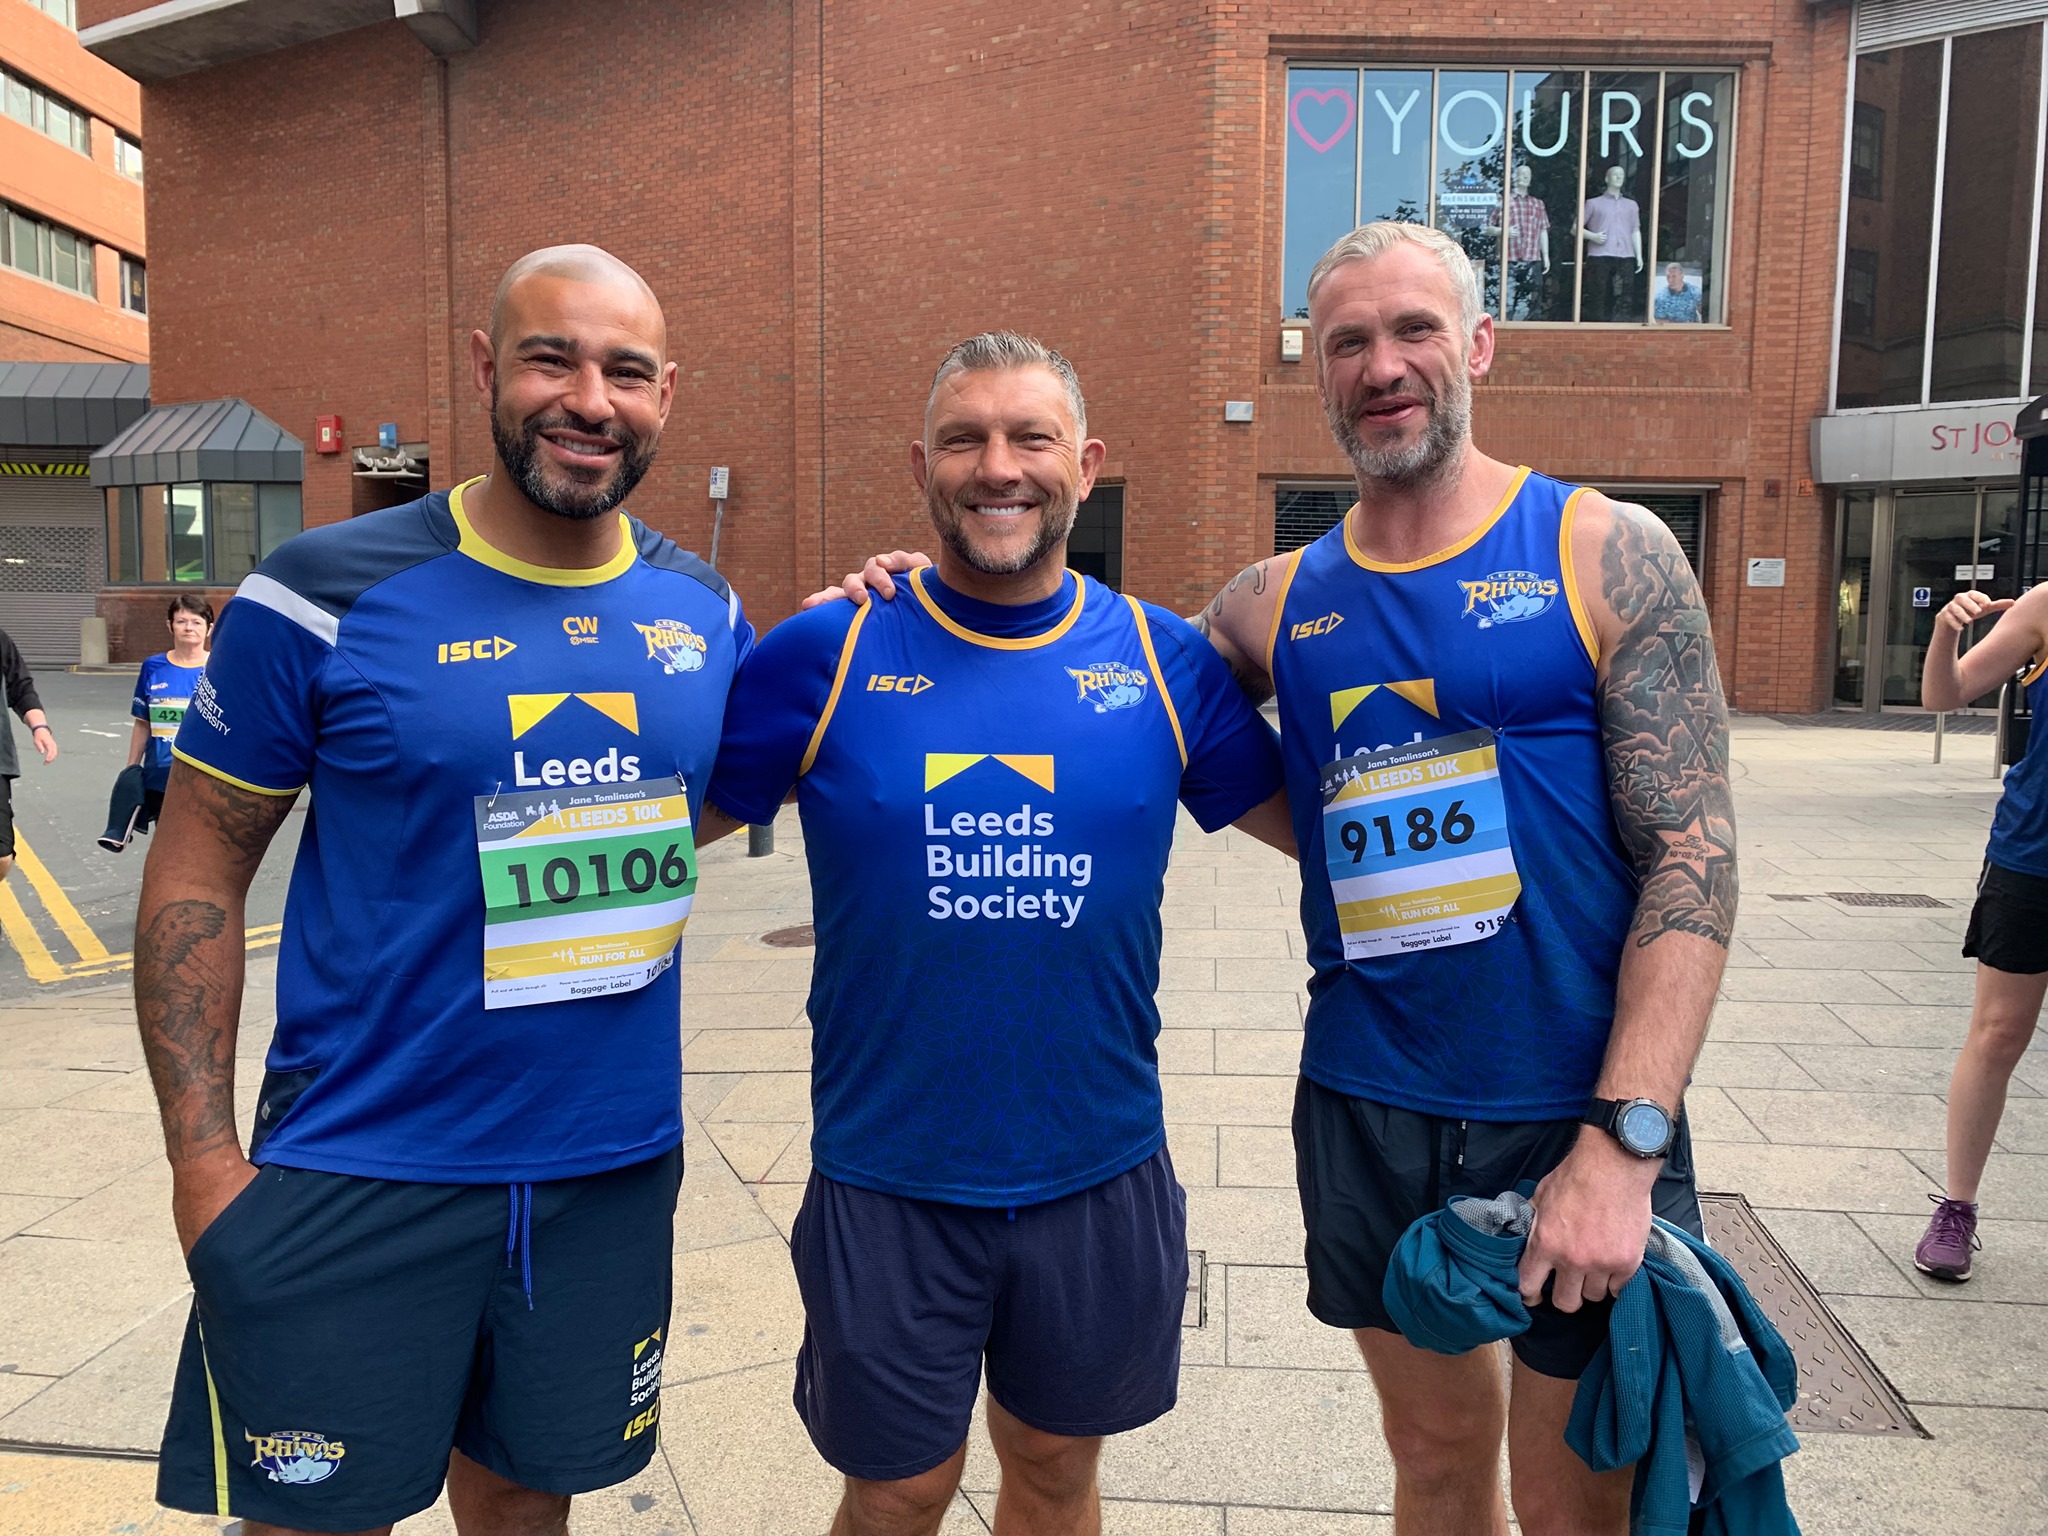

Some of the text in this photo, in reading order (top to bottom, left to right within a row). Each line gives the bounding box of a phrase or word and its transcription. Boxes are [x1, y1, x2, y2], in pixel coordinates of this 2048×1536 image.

[1375, 89, 1714, 159] YOURS
[1931, 421, 2021, 454] ST JO
[563, 616, 599, 635] CW
[1290, 616, 1329, 641] ISC
[438, 639, 492, 664] ISC
[866, 673, 914, 693] ISC
[513, 747, 641, 787] Leeds
[1367, 747, 1440, 770] Jane Tomlinson's
[1370, 758, 1461, 791] LEEDS 10K
[568, 790, 646, 806] Jane Tomlinson's
[483, 819, 525, 831] Foundation
[488, 810, 519, 824] ASDA
[569, 803, 663, 829] LEEDS 10K
[924, 803, 1055, 837] Leeds
[1340, 799, 1475, 864] 9186
[507, 843, 688, 909] 10106
[926, 844, 1092, 887] Building
[927, 885, 1085, 929] Society
[1401, 902, 1460, 921] RUN FOR ALL
[1475, 915, 1505, 933] 918
[1400, 933, 1452, 948] Baggage Label
[580, 948, 646, 965] RUN FOR ALL
[570, 978, 632, 995] Baggage Label
[633, 1349, 661, 1377] Leeds
